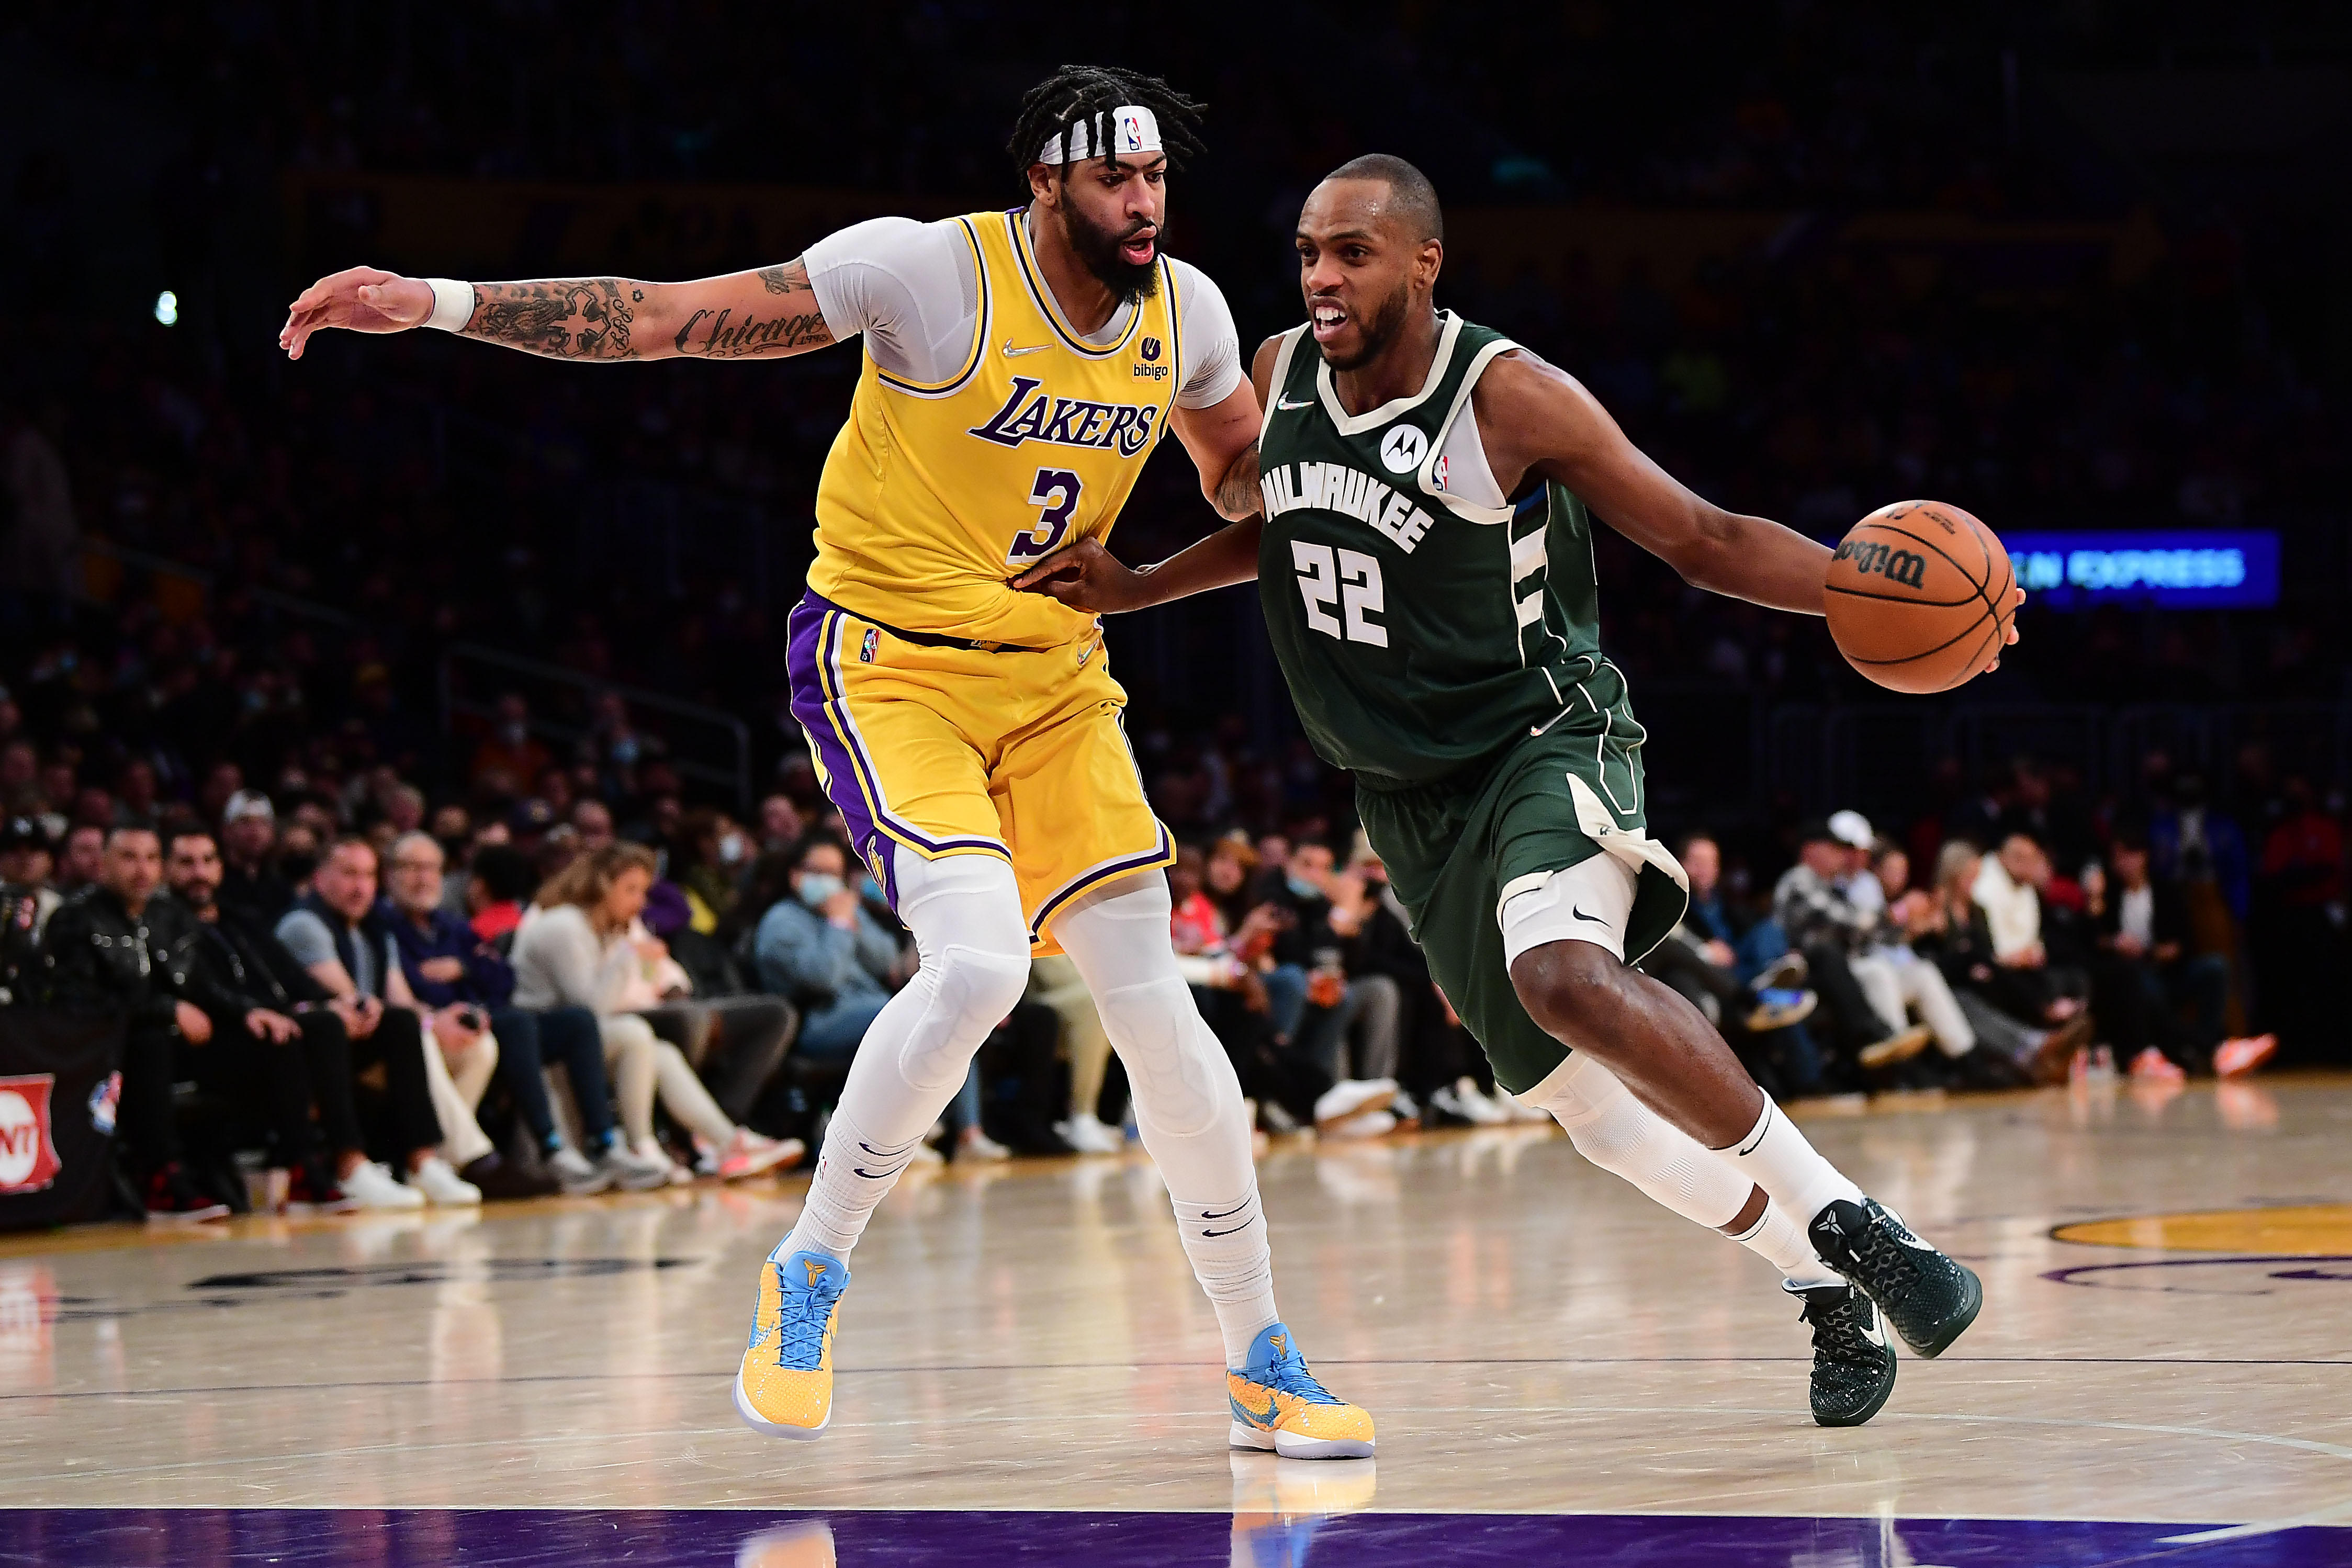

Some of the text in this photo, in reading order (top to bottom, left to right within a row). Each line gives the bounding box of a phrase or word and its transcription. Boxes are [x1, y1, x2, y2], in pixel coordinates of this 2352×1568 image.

[966, 376, 1159, 457] LAKERS
[1133, 363, 1168, 381] bibigo
[1006, 467, 1083, 565] 3
[1259, 462, 1434, 554] MILWAUKEE
[1291, 540, 1388, 648] 22
